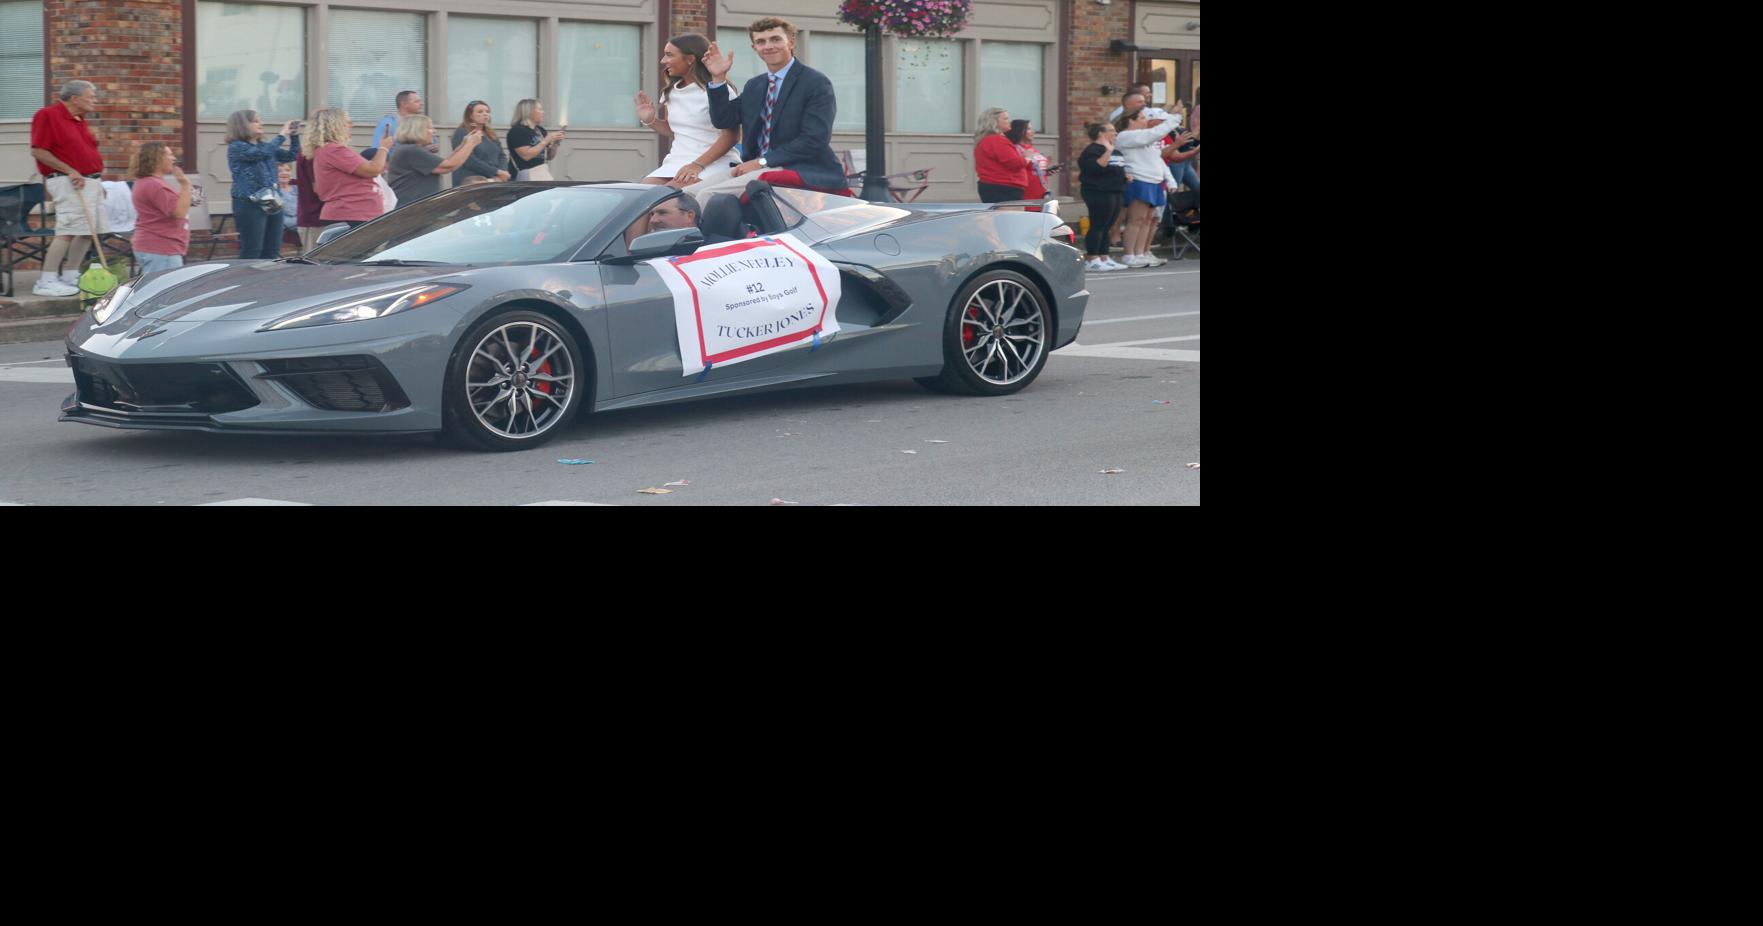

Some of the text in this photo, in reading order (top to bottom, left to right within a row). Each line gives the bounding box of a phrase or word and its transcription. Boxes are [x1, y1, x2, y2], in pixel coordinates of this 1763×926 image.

[700, 256, 795, 289] MOLLIE NEELEY
[725, 286, 798, 310] Sponsored by Boys Golf
[746, 282, 765, 294] #12
[717, 303, 814, 338] TUCKER JONES
